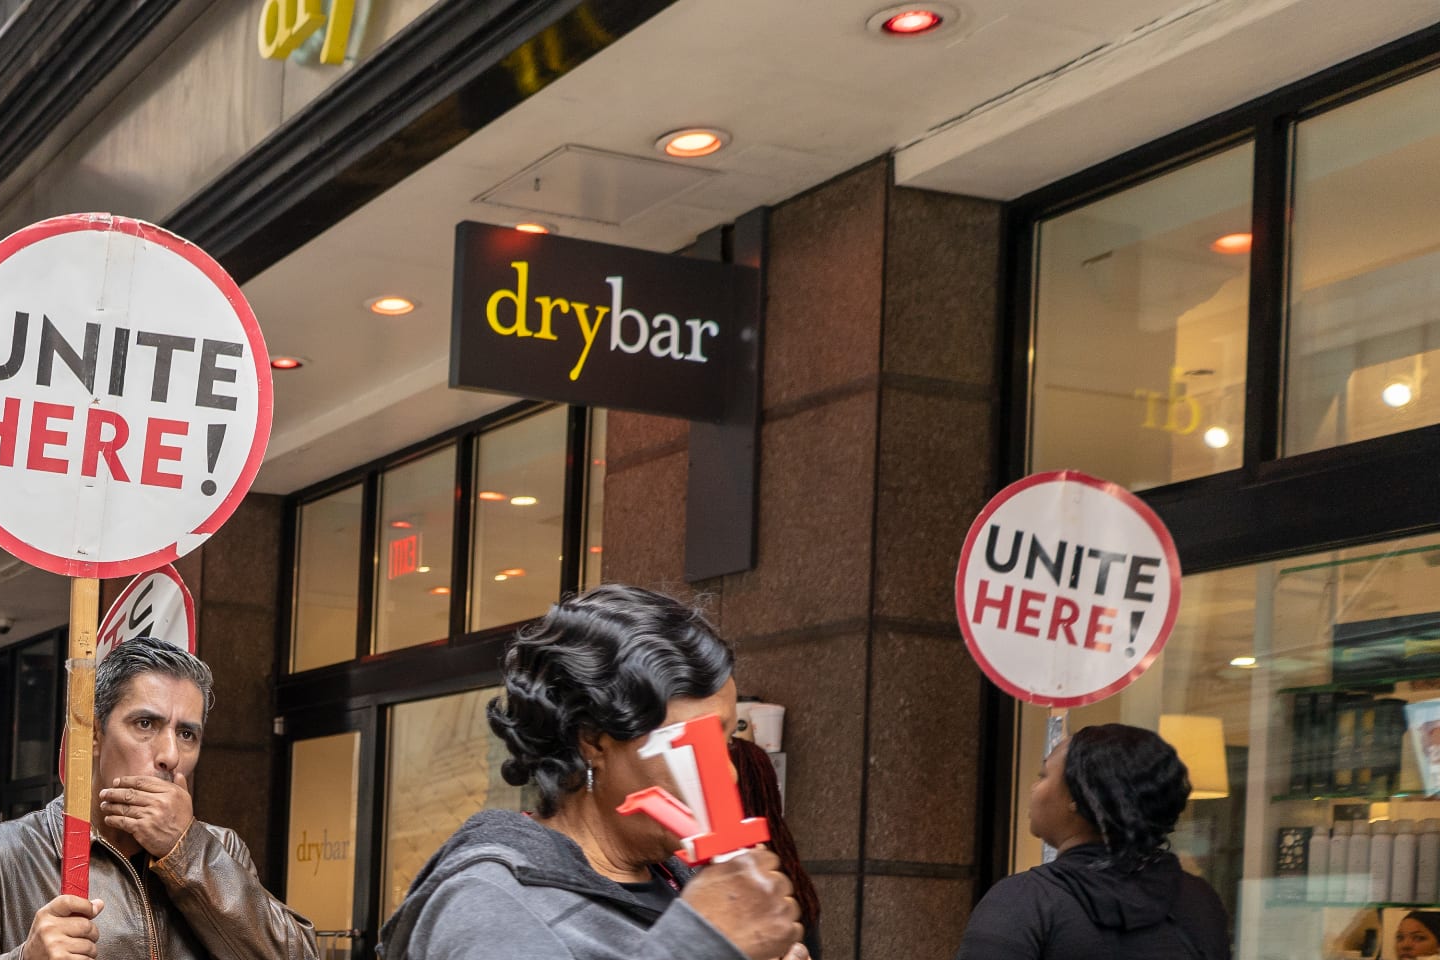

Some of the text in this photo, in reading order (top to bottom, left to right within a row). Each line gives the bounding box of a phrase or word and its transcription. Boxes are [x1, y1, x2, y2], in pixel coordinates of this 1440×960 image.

[485, 261, 720, 381] drybar
[984, 524, 1161, 603] UNITE
[295, 829, 351, 877] drybar
